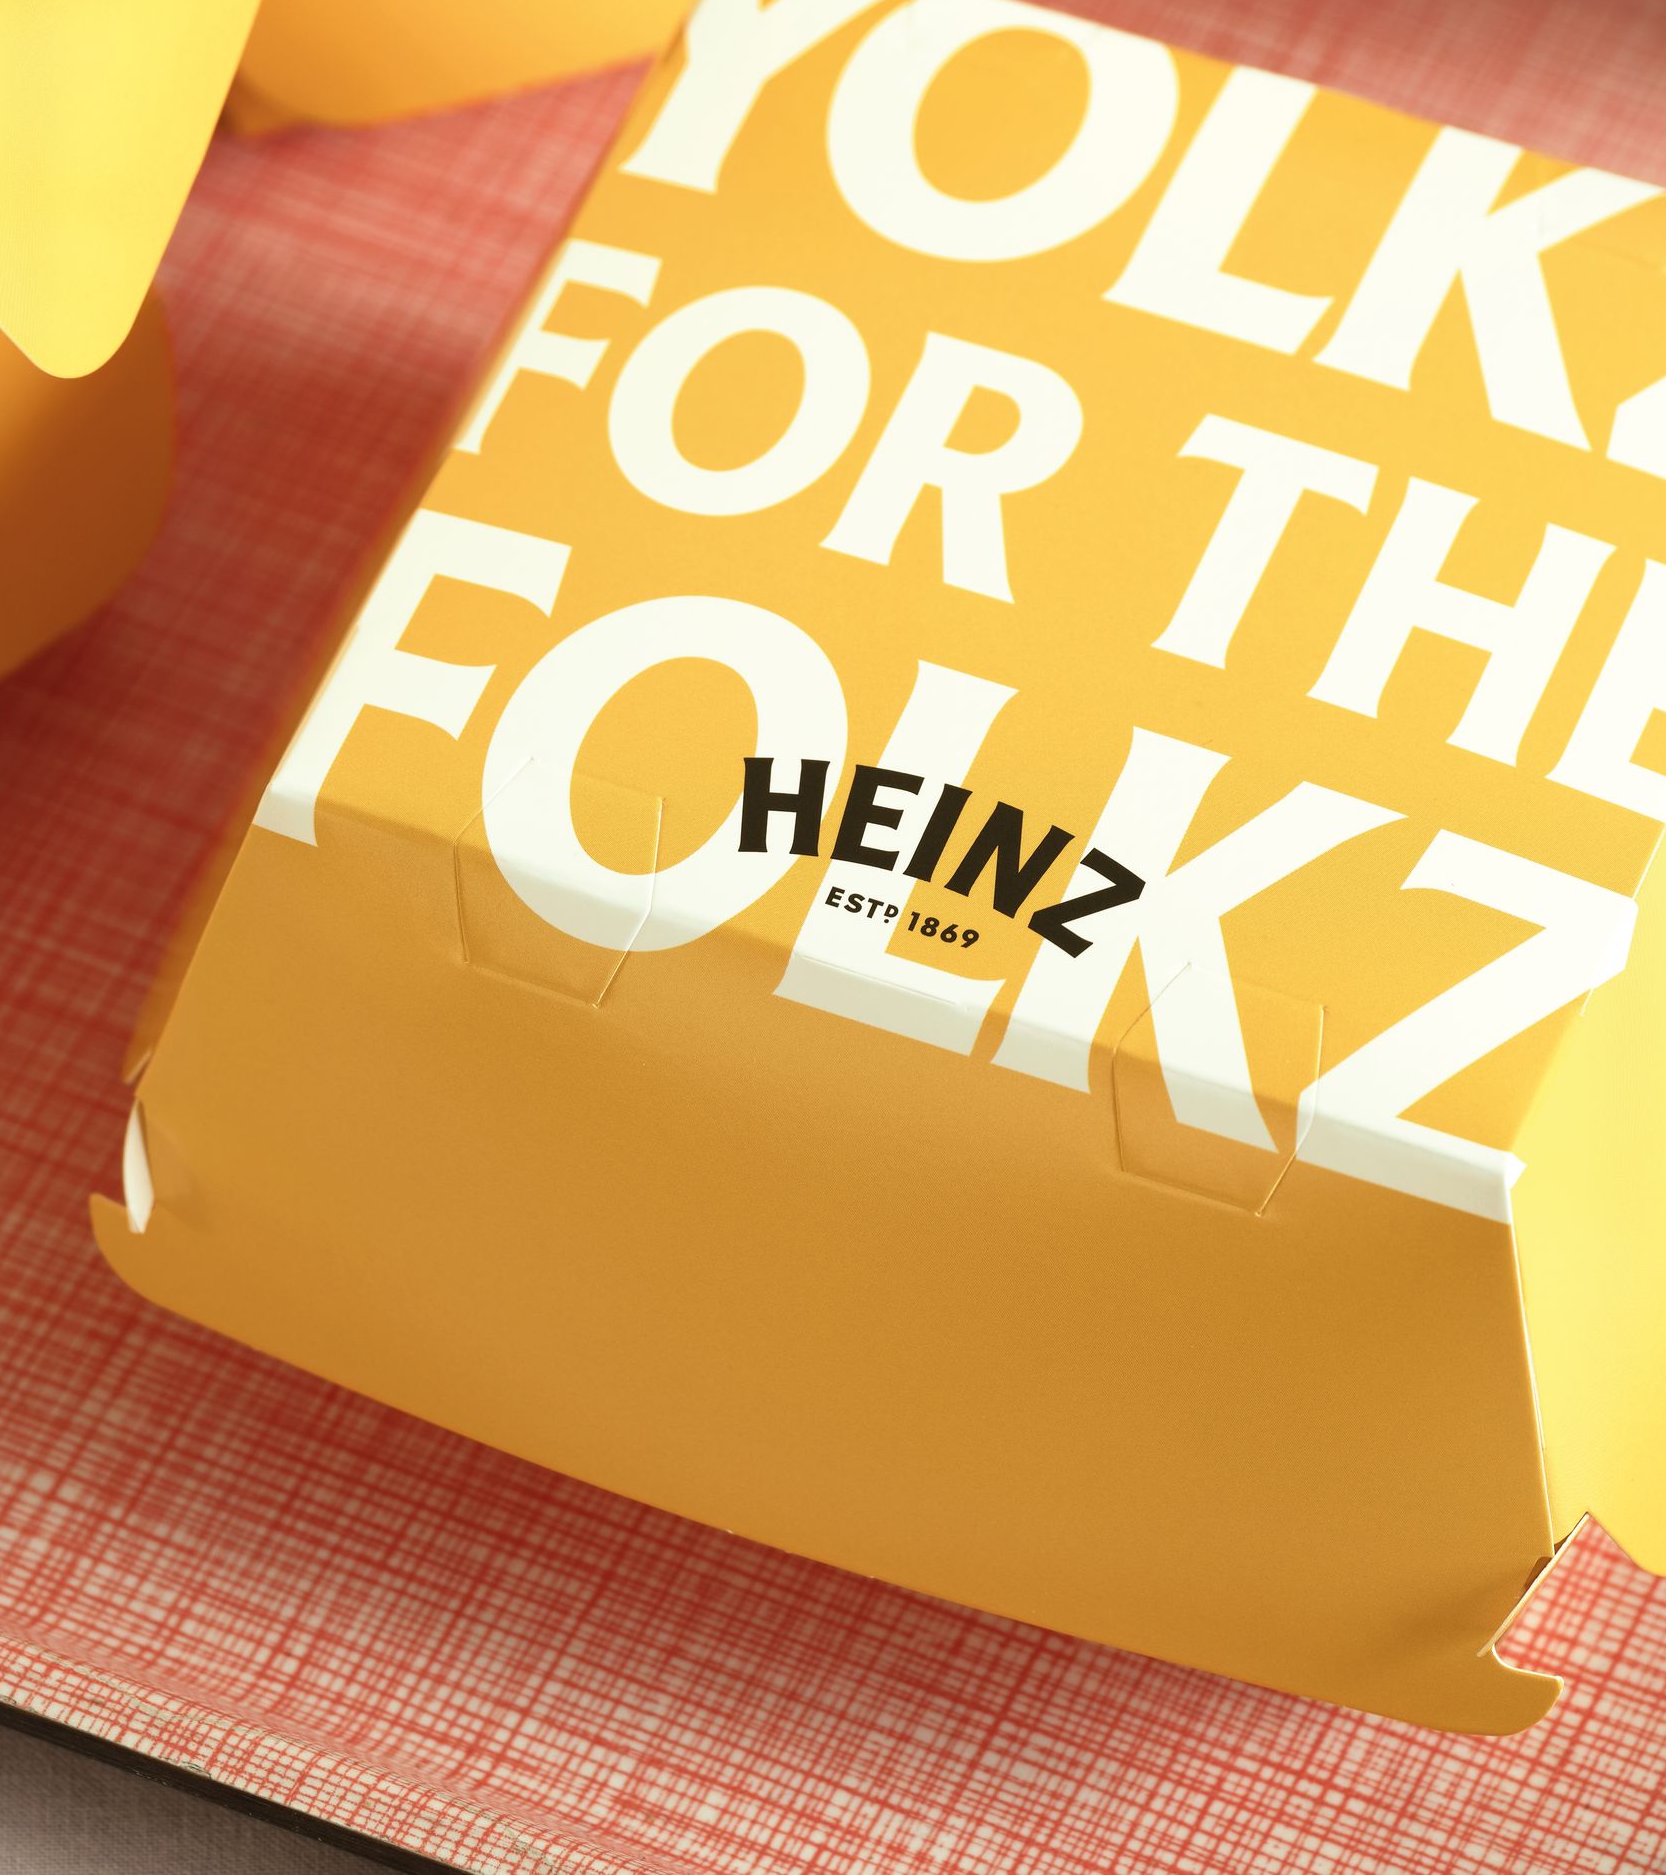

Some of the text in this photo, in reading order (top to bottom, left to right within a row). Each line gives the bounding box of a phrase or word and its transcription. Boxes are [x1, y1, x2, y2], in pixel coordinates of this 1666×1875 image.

[453, 237, 1084, 605] FOR
[251, 508, 1639, 1225] FOLKZ
[737, 757, 1146, 959] HEINZ
[909, 910, 981, 951] 1869
